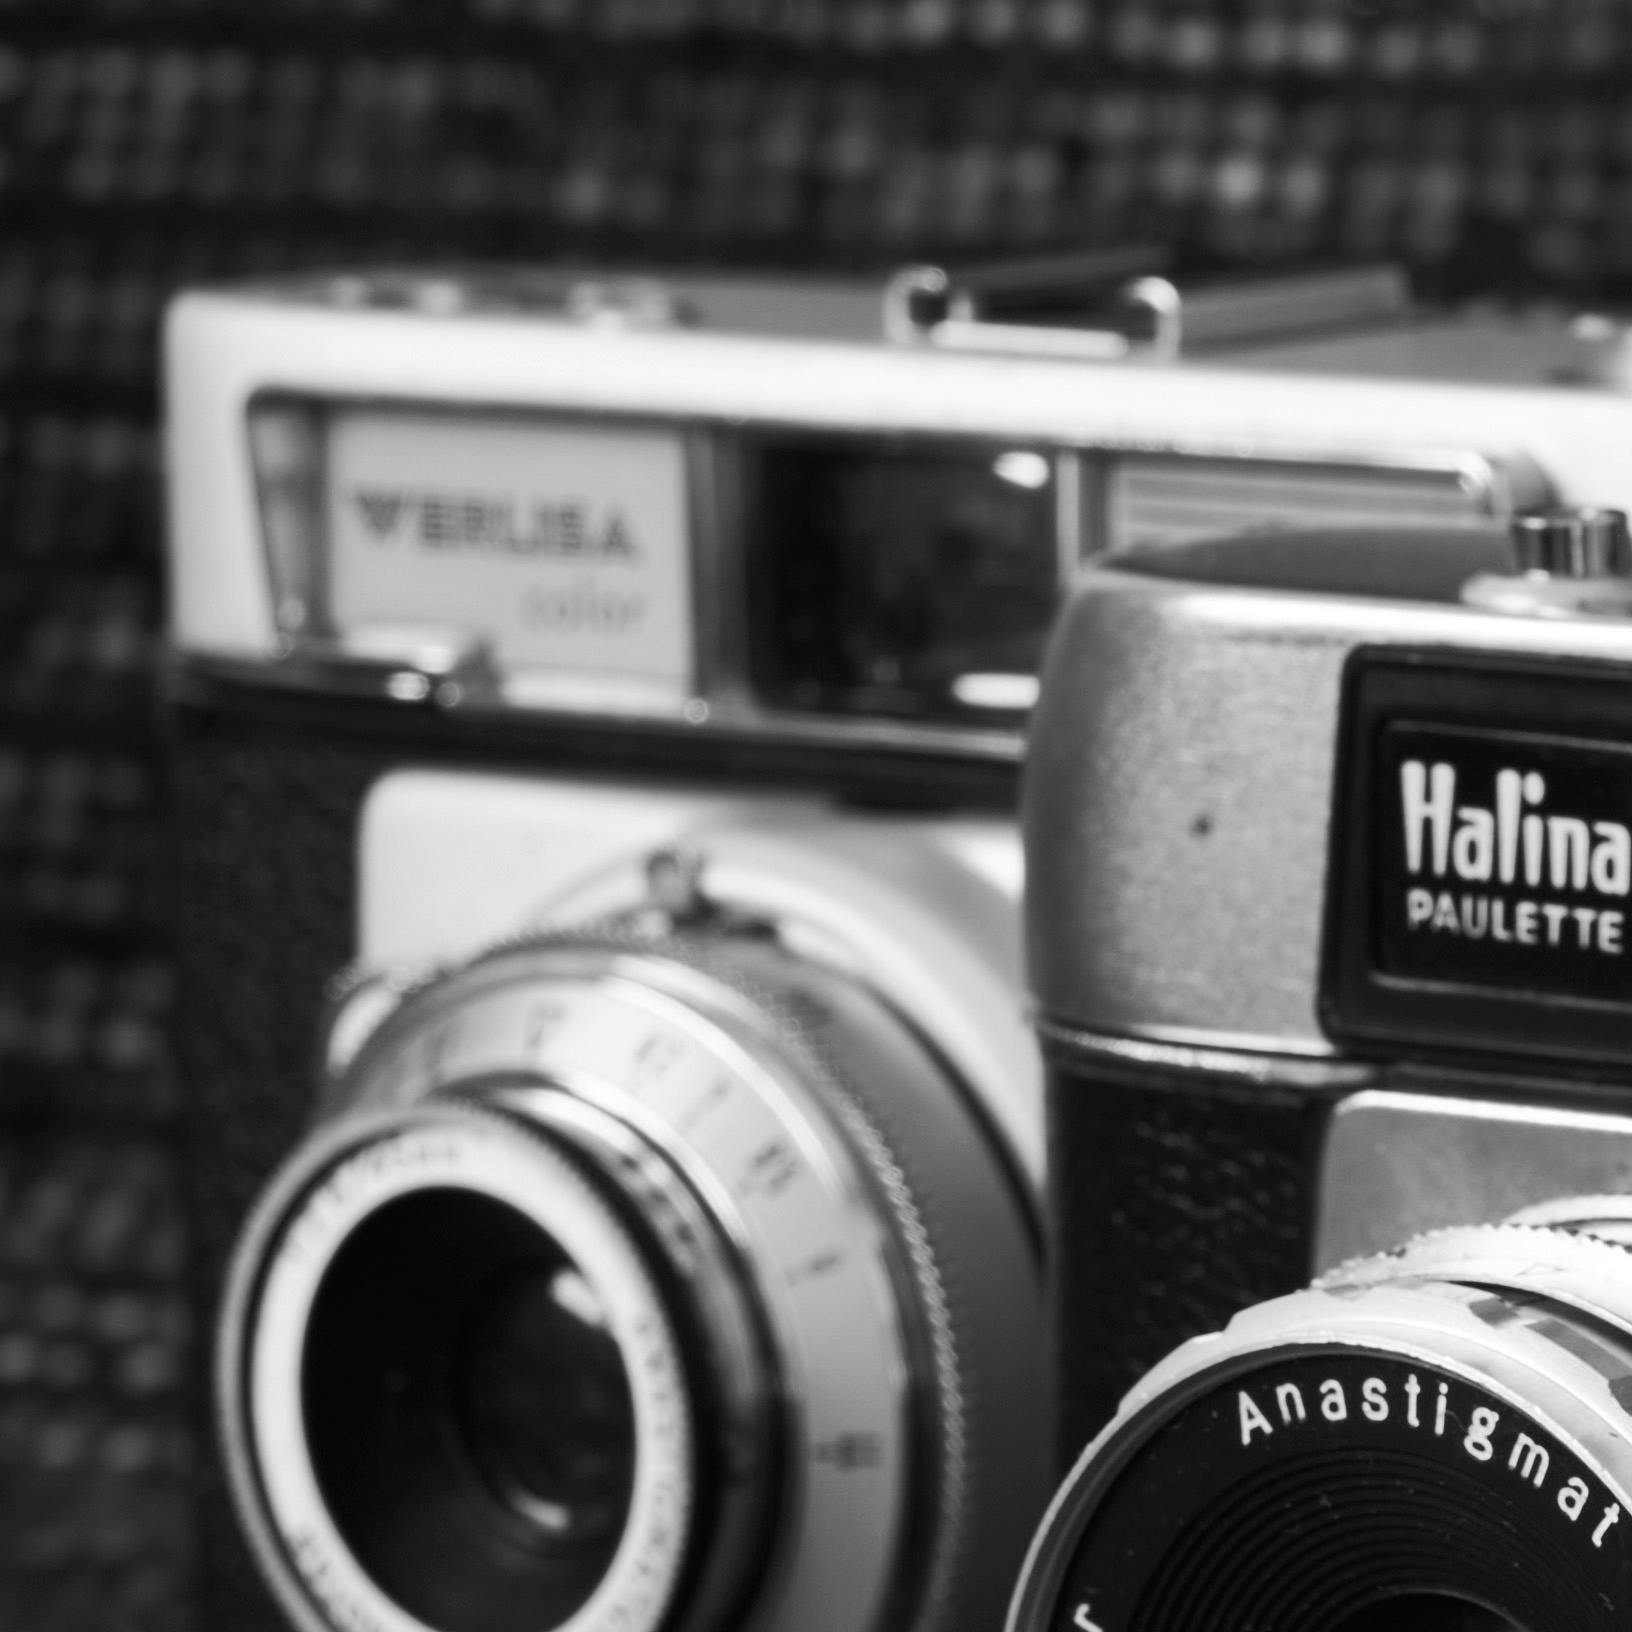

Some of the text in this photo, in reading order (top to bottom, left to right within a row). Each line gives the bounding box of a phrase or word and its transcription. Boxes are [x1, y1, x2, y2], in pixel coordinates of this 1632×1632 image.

[1401, 760, 1632, 897] Halina
[1407, 888, 1625, 955] PAULETTE
[1237, 1371, 1621, 1549] Anastigmat
